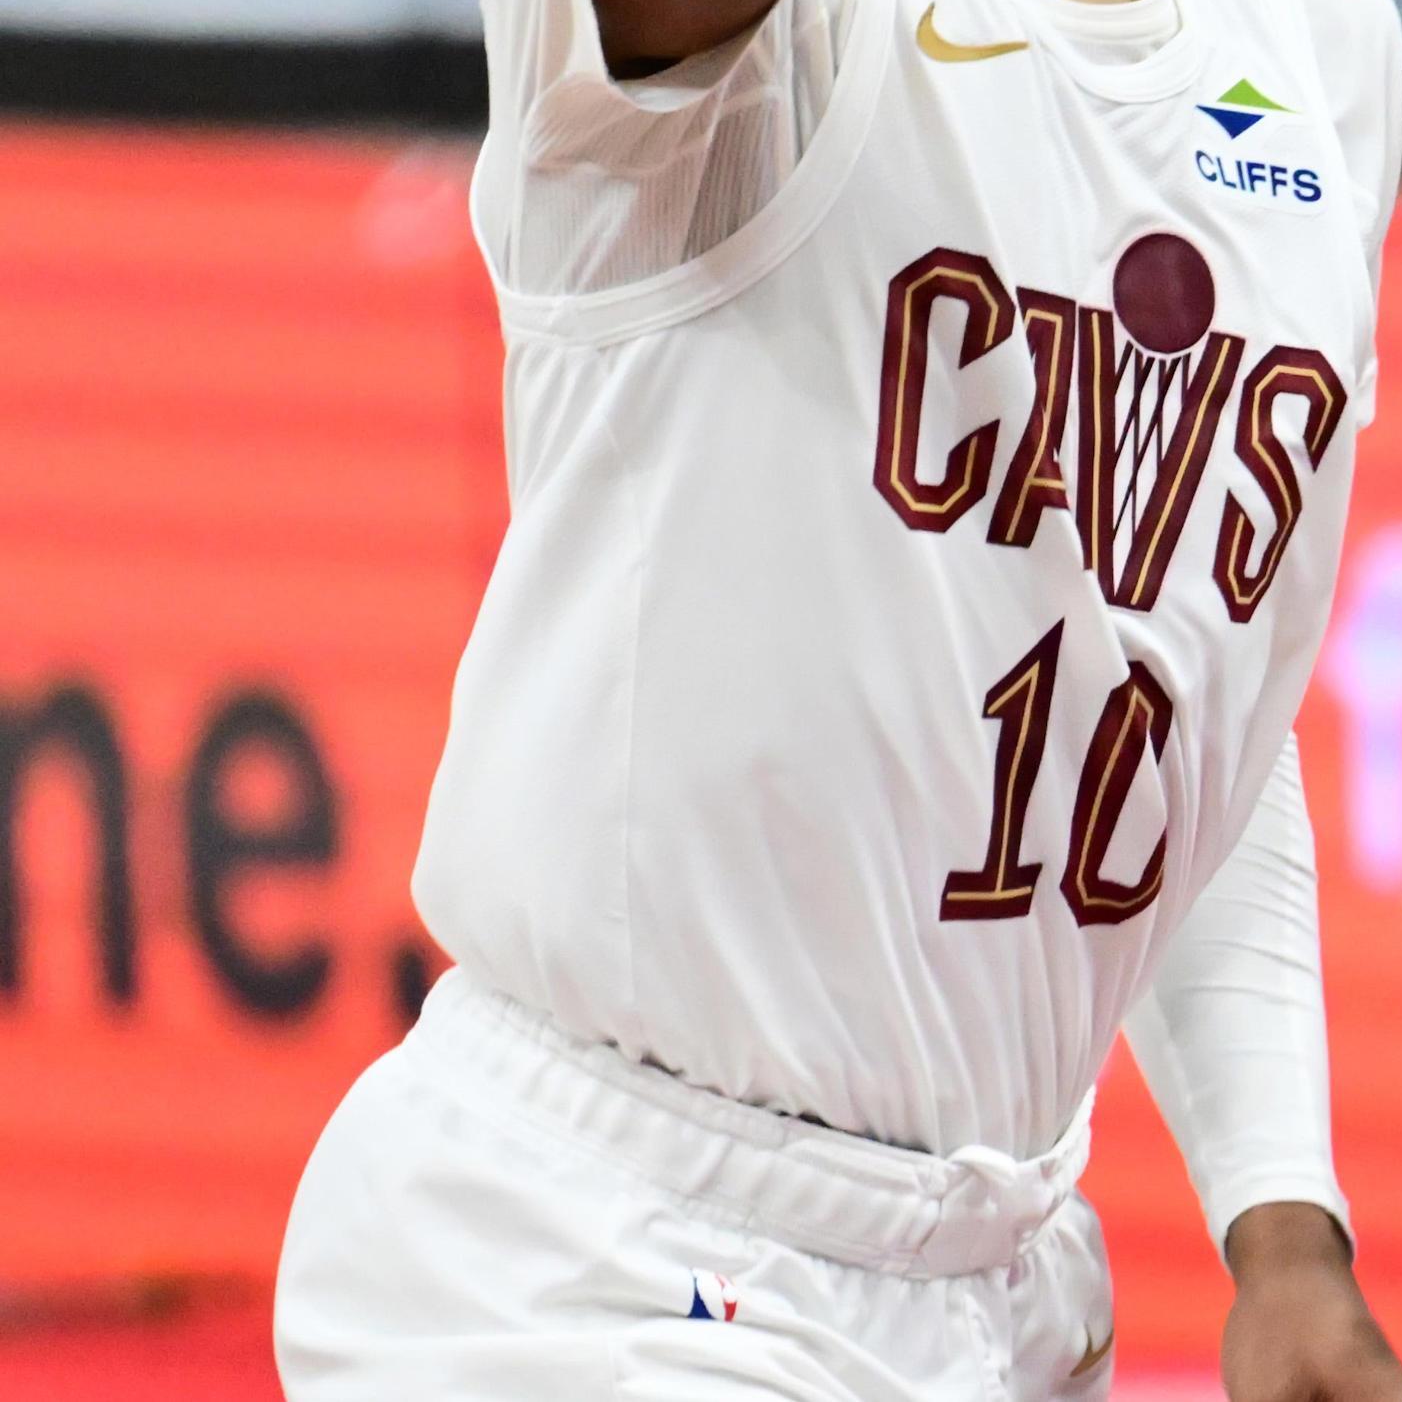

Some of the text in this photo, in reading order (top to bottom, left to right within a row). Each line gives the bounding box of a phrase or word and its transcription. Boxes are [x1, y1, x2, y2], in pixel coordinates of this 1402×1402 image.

[1194, 149, 1323, 203] CLIFFS
[872, 245, 1349, 625] CAVS
[938, 616, 1174, 929] 10
